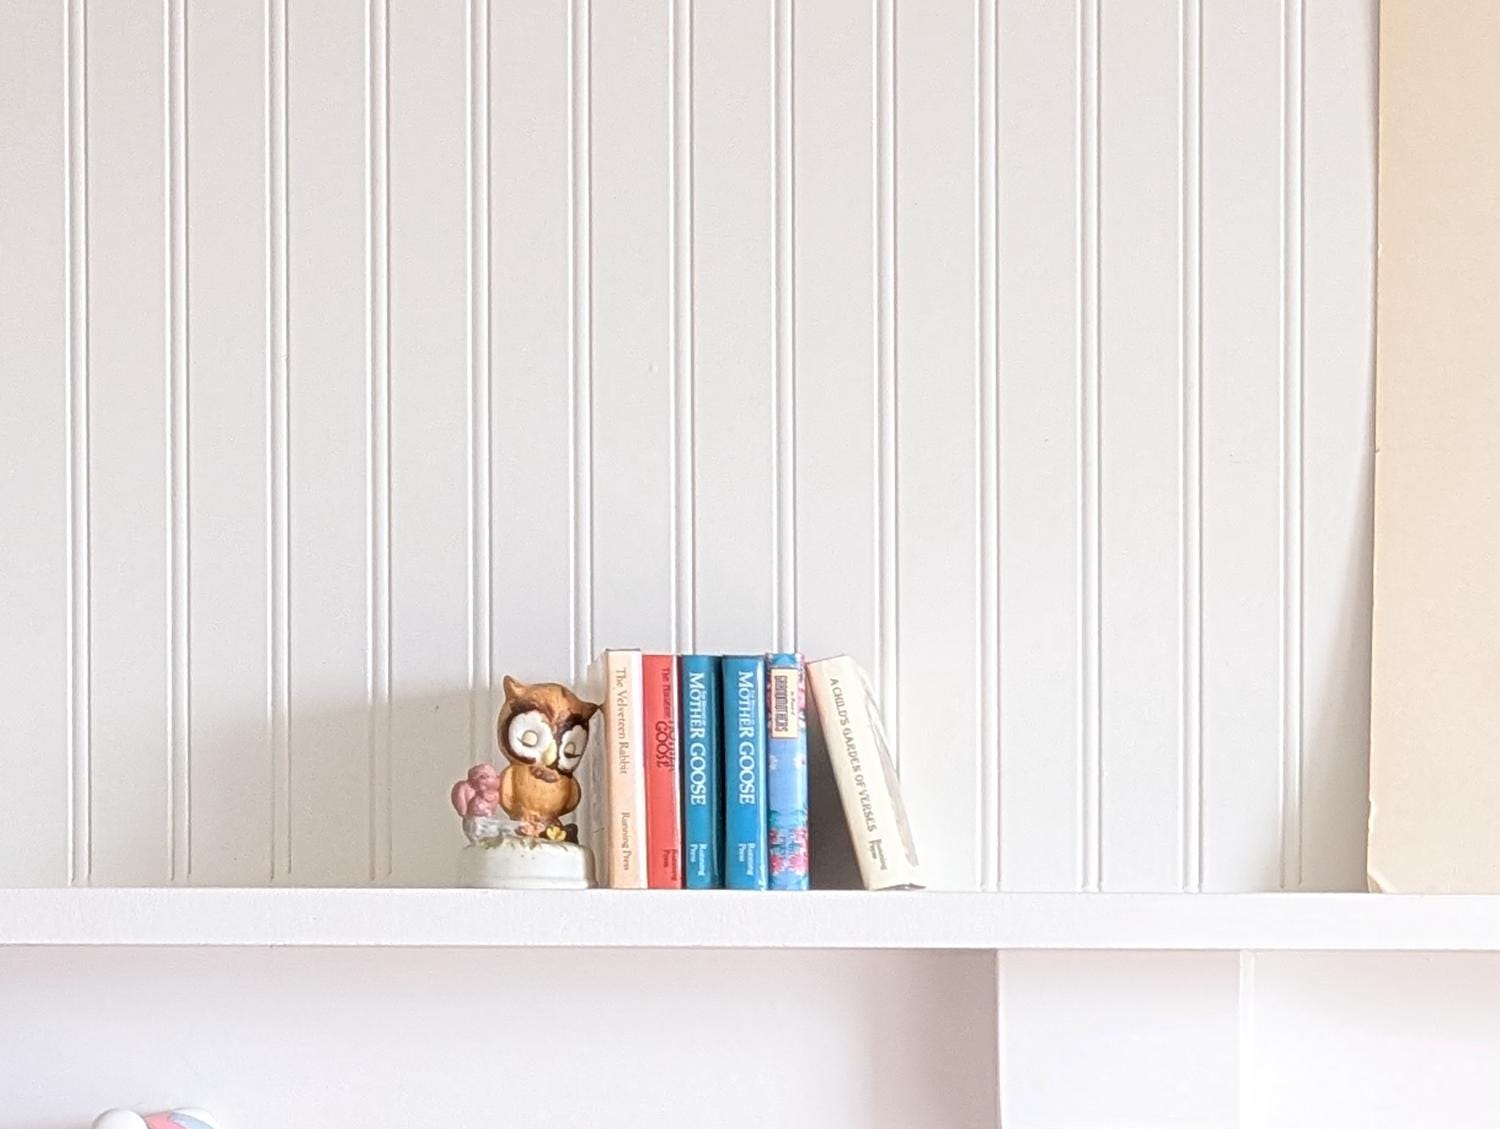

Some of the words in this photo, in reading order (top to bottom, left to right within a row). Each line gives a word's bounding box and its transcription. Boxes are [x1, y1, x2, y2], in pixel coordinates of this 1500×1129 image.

[616, 668, 626, 688] The
[661, 668, 671, 683] The
[830, 678, 839, 686] A
[616, 690, 628, 740] Velveteen
[688, 672, 706, 739] MOTHER
[738, 671, 755, 738] MOTHER
[832, 686, 850, 726] CHILD'S
[618, 742, 631, 775] Rabbit
[655, 720, 669, 769] GOOSE
[842, 727, 862, 773] GARDEN
[690, 742, 707, 806] GOOSE
[739, 741, 756, 805] GOOSE
[854, 774, 867, 790] OF
[858, 789, 878, 832] VERSES
[621, 812, 631, 849] Running
[622, 850, 632, 871] Press
[690, 843, 699, 862] Press
[697, 843, 708, 876] Running
[738, 843, 747, 862] Press
[746, 843, 756, 876] Running
